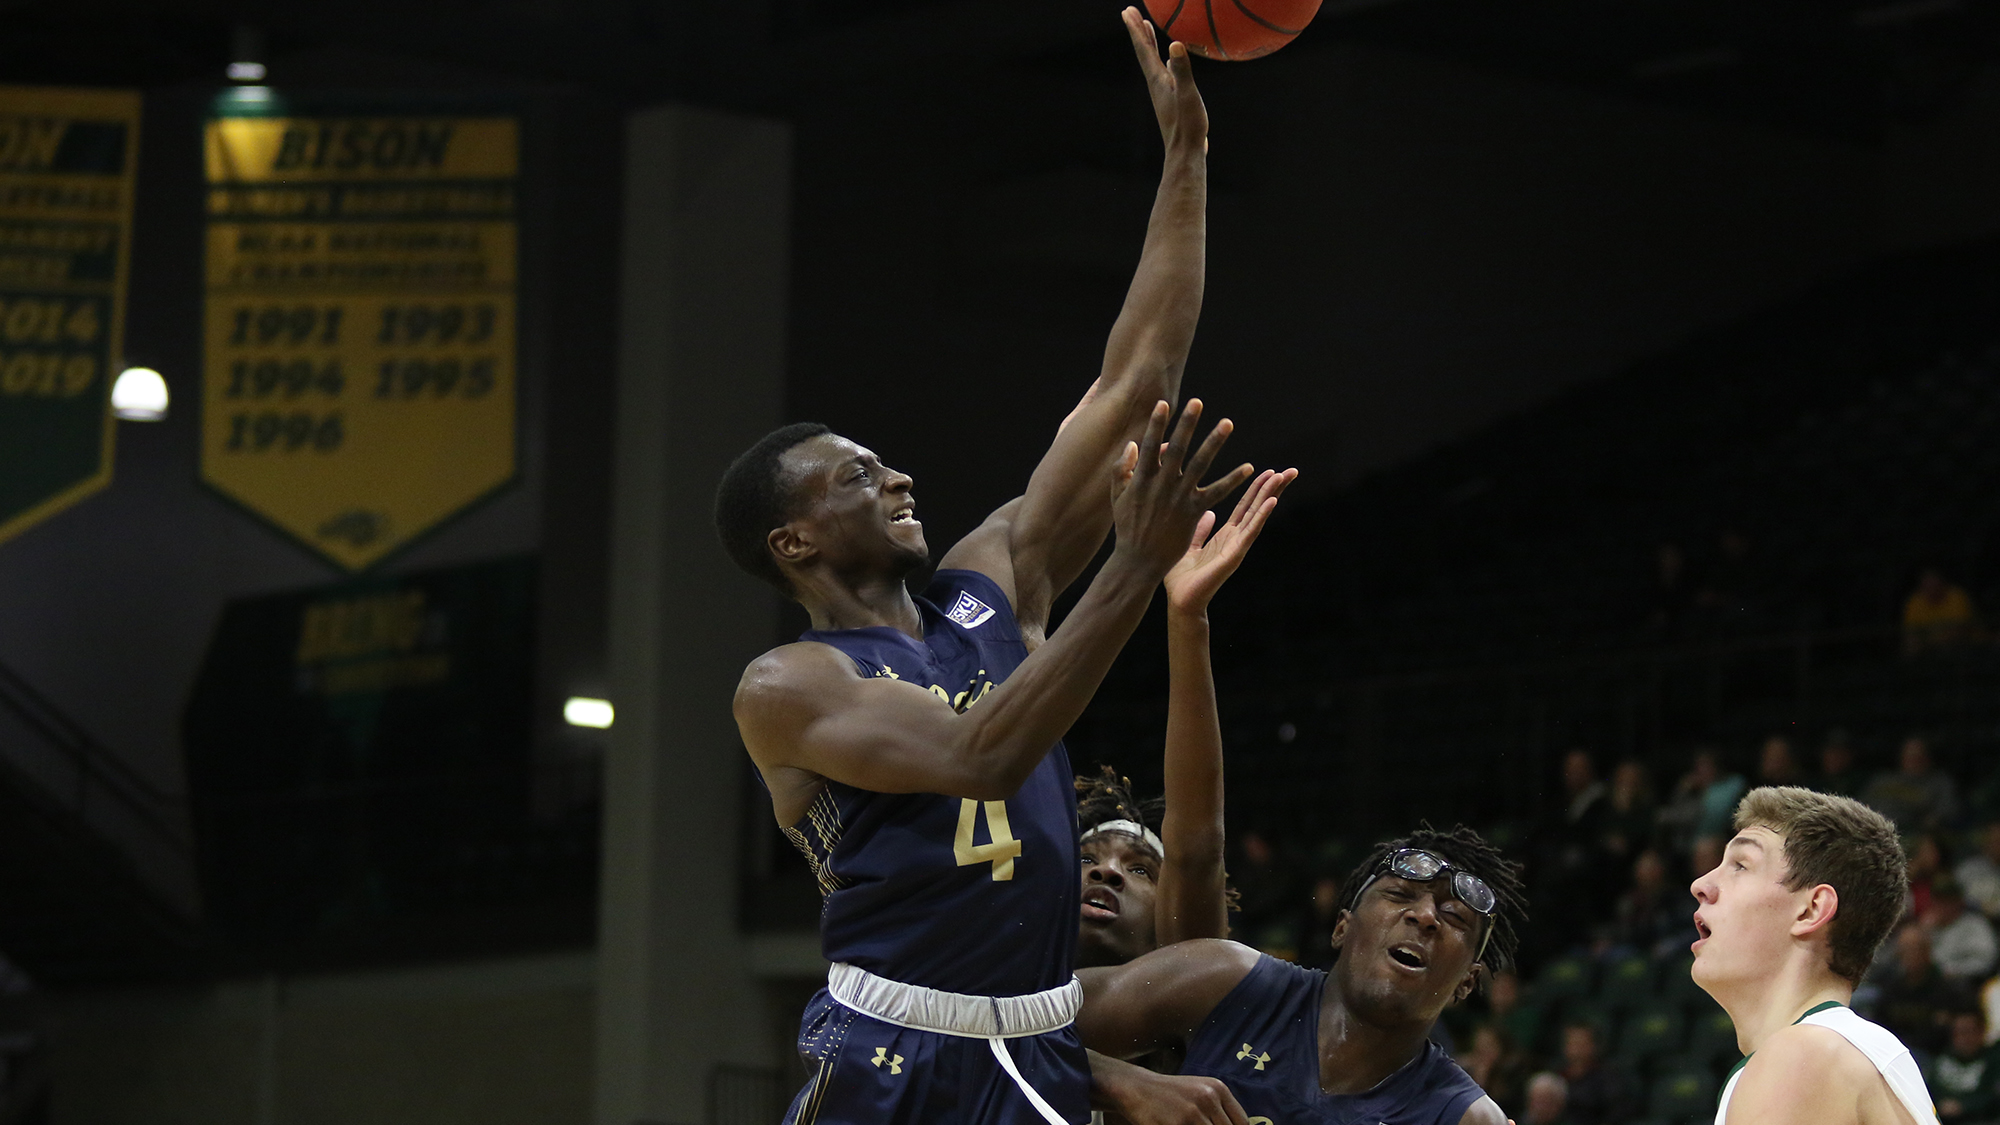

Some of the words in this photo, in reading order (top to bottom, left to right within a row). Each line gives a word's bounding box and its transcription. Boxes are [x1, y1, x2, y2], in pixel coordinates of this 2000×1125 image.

[276, 127, 455, 168] BISON
[0, 302, 99, 343] 014
[229, 307, 343, 346] 1991
[377, 305, 496, 345] 1993
[0, 352, 96, 395] 019
[226, 359, 345, 398] 1994
[374, 358, 496, 398] 1995
[226, 413, 343, 452] 1996
[953, 596, 978, 620] SKY
[953, 797, 1021, 881] 4
